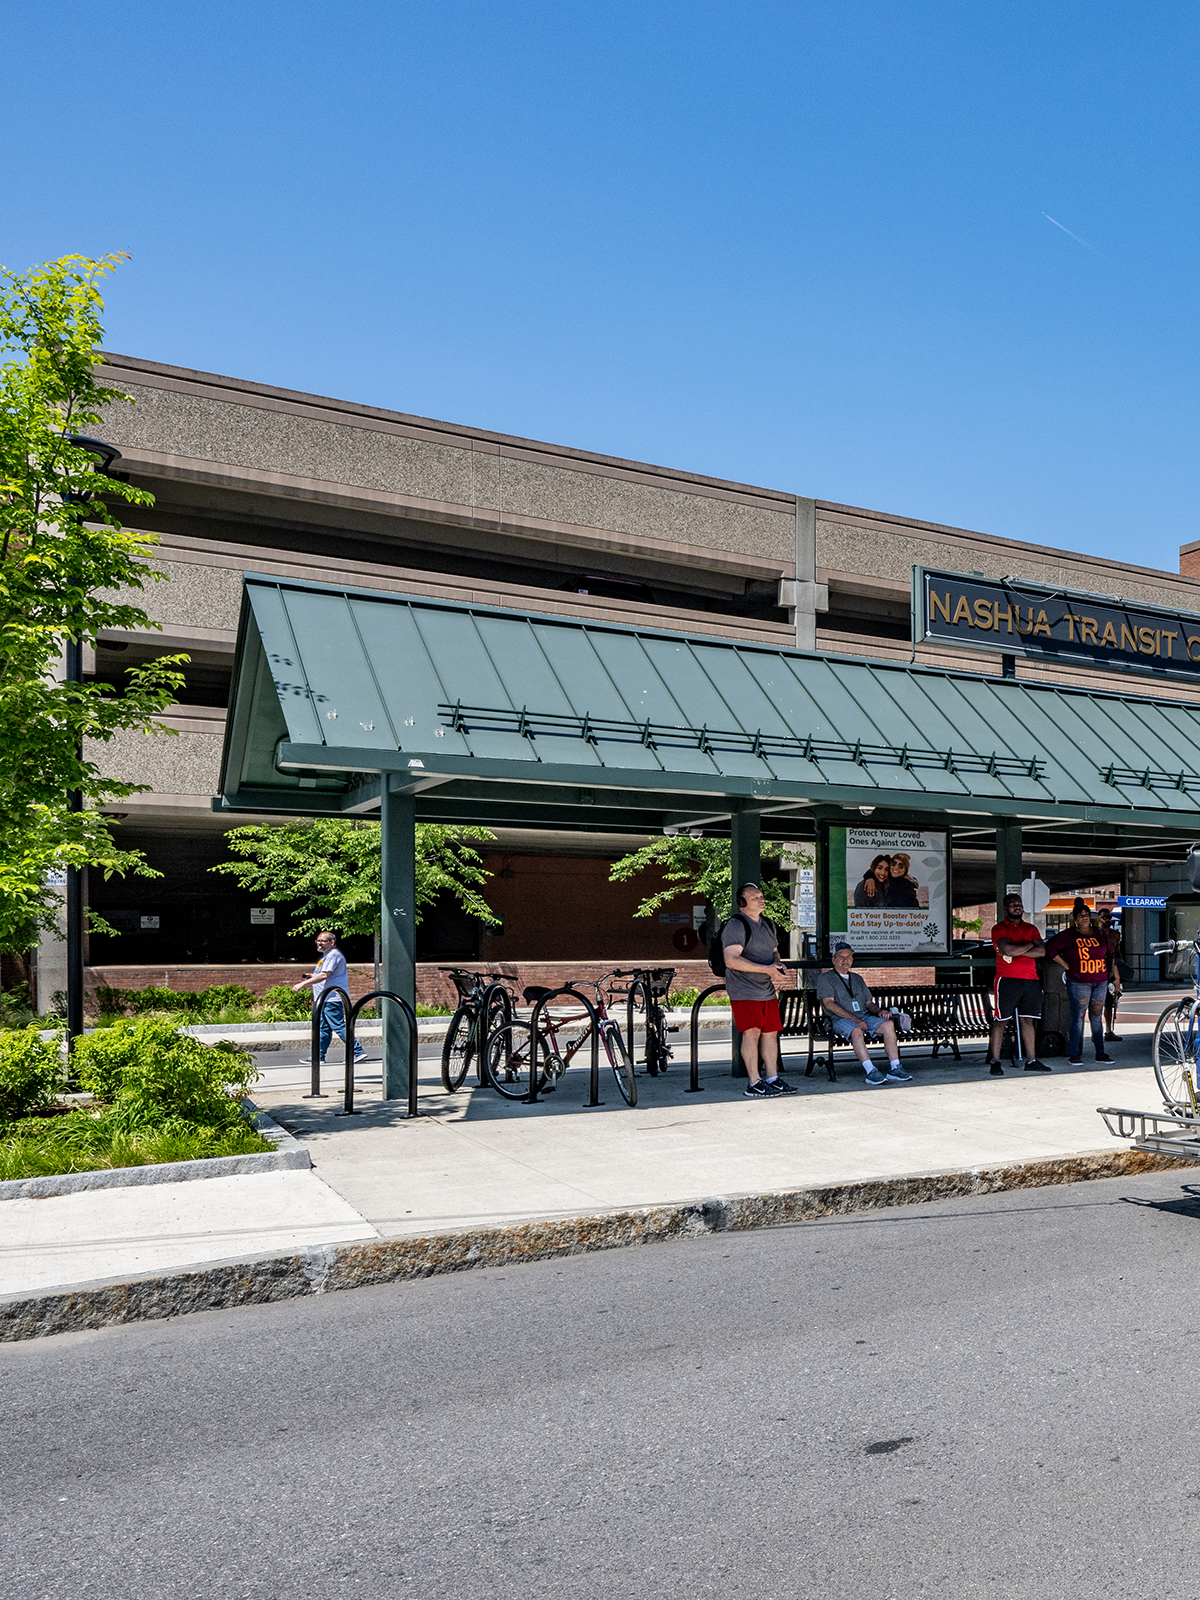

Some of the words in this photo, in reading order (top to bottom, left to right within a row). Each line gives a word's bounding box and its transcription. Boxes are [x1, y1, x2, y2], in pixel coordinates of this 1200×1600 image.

[929, 590, 1052, 638] NASHUA
[1063, 613, 1178, 659] TRANSIT
[849, 828, 878, 837] Protect
[880, 830, 897, 838] Your
[898, 831, 921, 839] Loved
[870, 838, 899, 847] Against
[900, 840, 927, 848] COVID.
[1125, 898, 1166, 906] CLEARANC
[866, 920, 882, 928] Stay
[883, 920, 923, 928] Up-to-date!
[683, 934, 688, 945] 1
[1076, 937, 1100, 948] GOD
[1078, 947, 1090, 960] IS
[1080, 959, 1107, 974] DOPE
